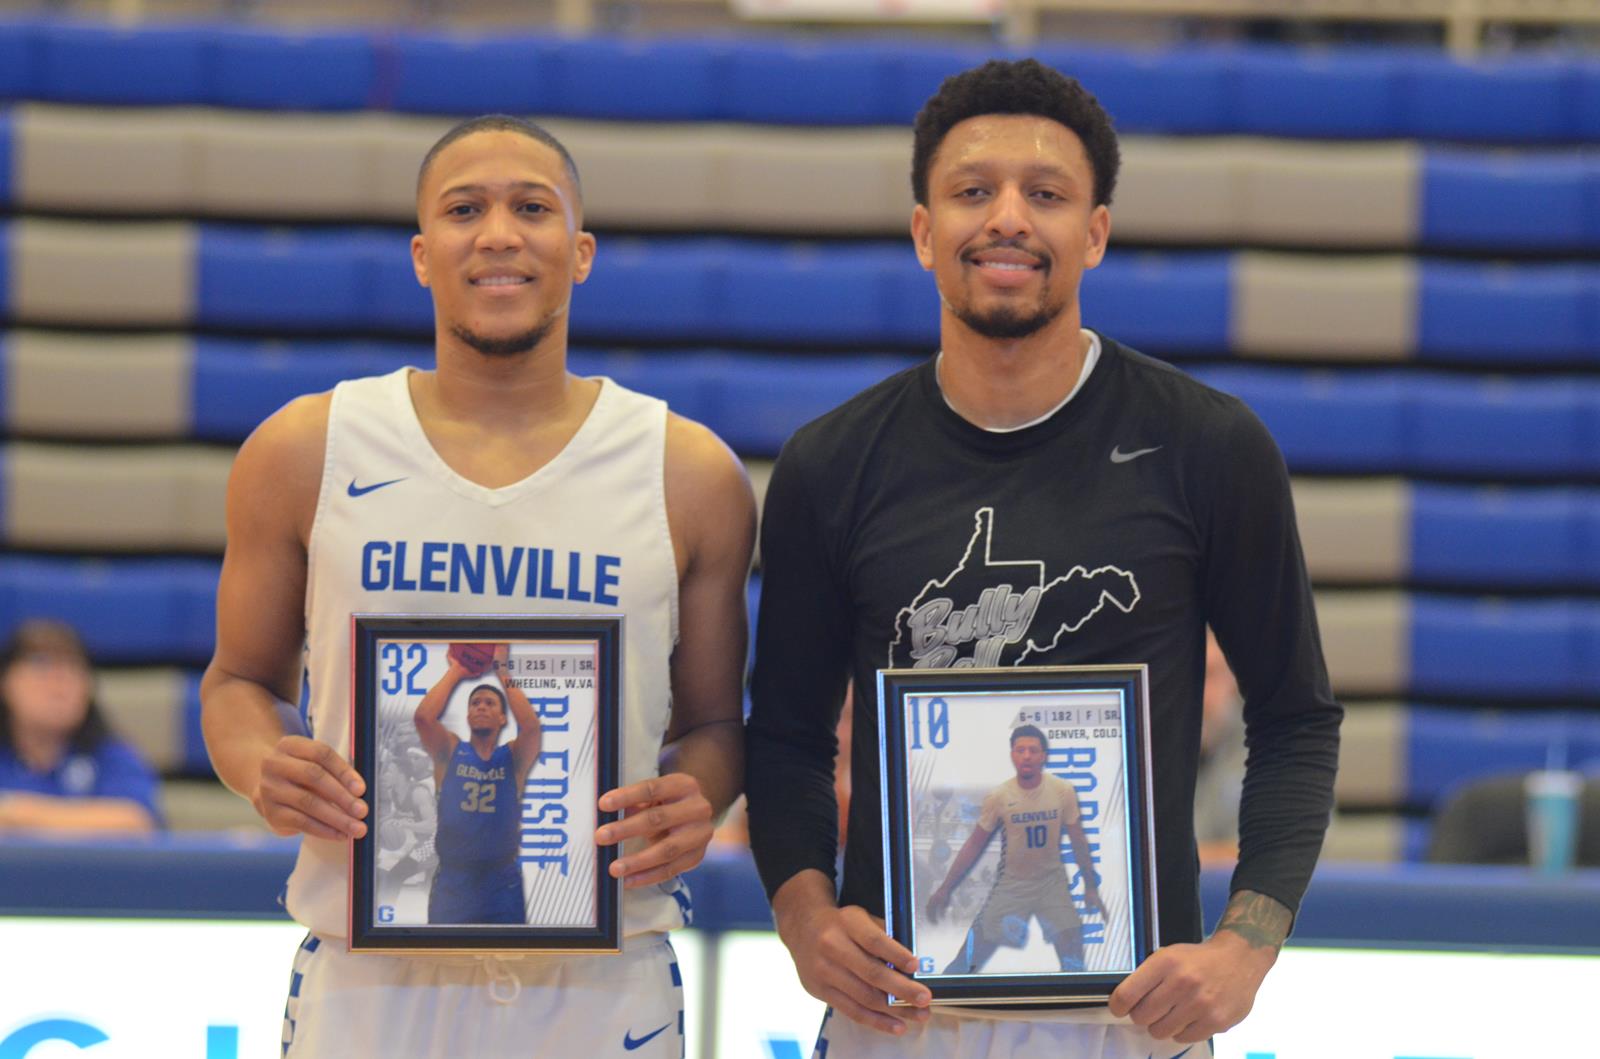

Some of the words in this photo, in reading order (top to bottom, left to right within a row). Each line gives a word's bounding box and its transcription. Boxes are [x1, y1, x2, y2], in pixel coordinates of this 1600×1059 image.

[361, 540, 621, 607] GLENVILLE
[907, 584, 1043, 659] Bully
[382, 643, 428, 695] 32
[526, 660, 546, 671] 215
[560, 660, 567, 671] F
[506, 678, 561, 690] WHEELING,
[910, 697, 949, 750] 10
[1020, 711, 1041, 722] 6-6
[1052, 710, 1072, 721] 182
[1086, 710, 1093, 720] F
[1048, 729, 1090, 740] DENVER,
[461, 781, 496, 813] 32
[1025, 825, 1047, 849] 10
